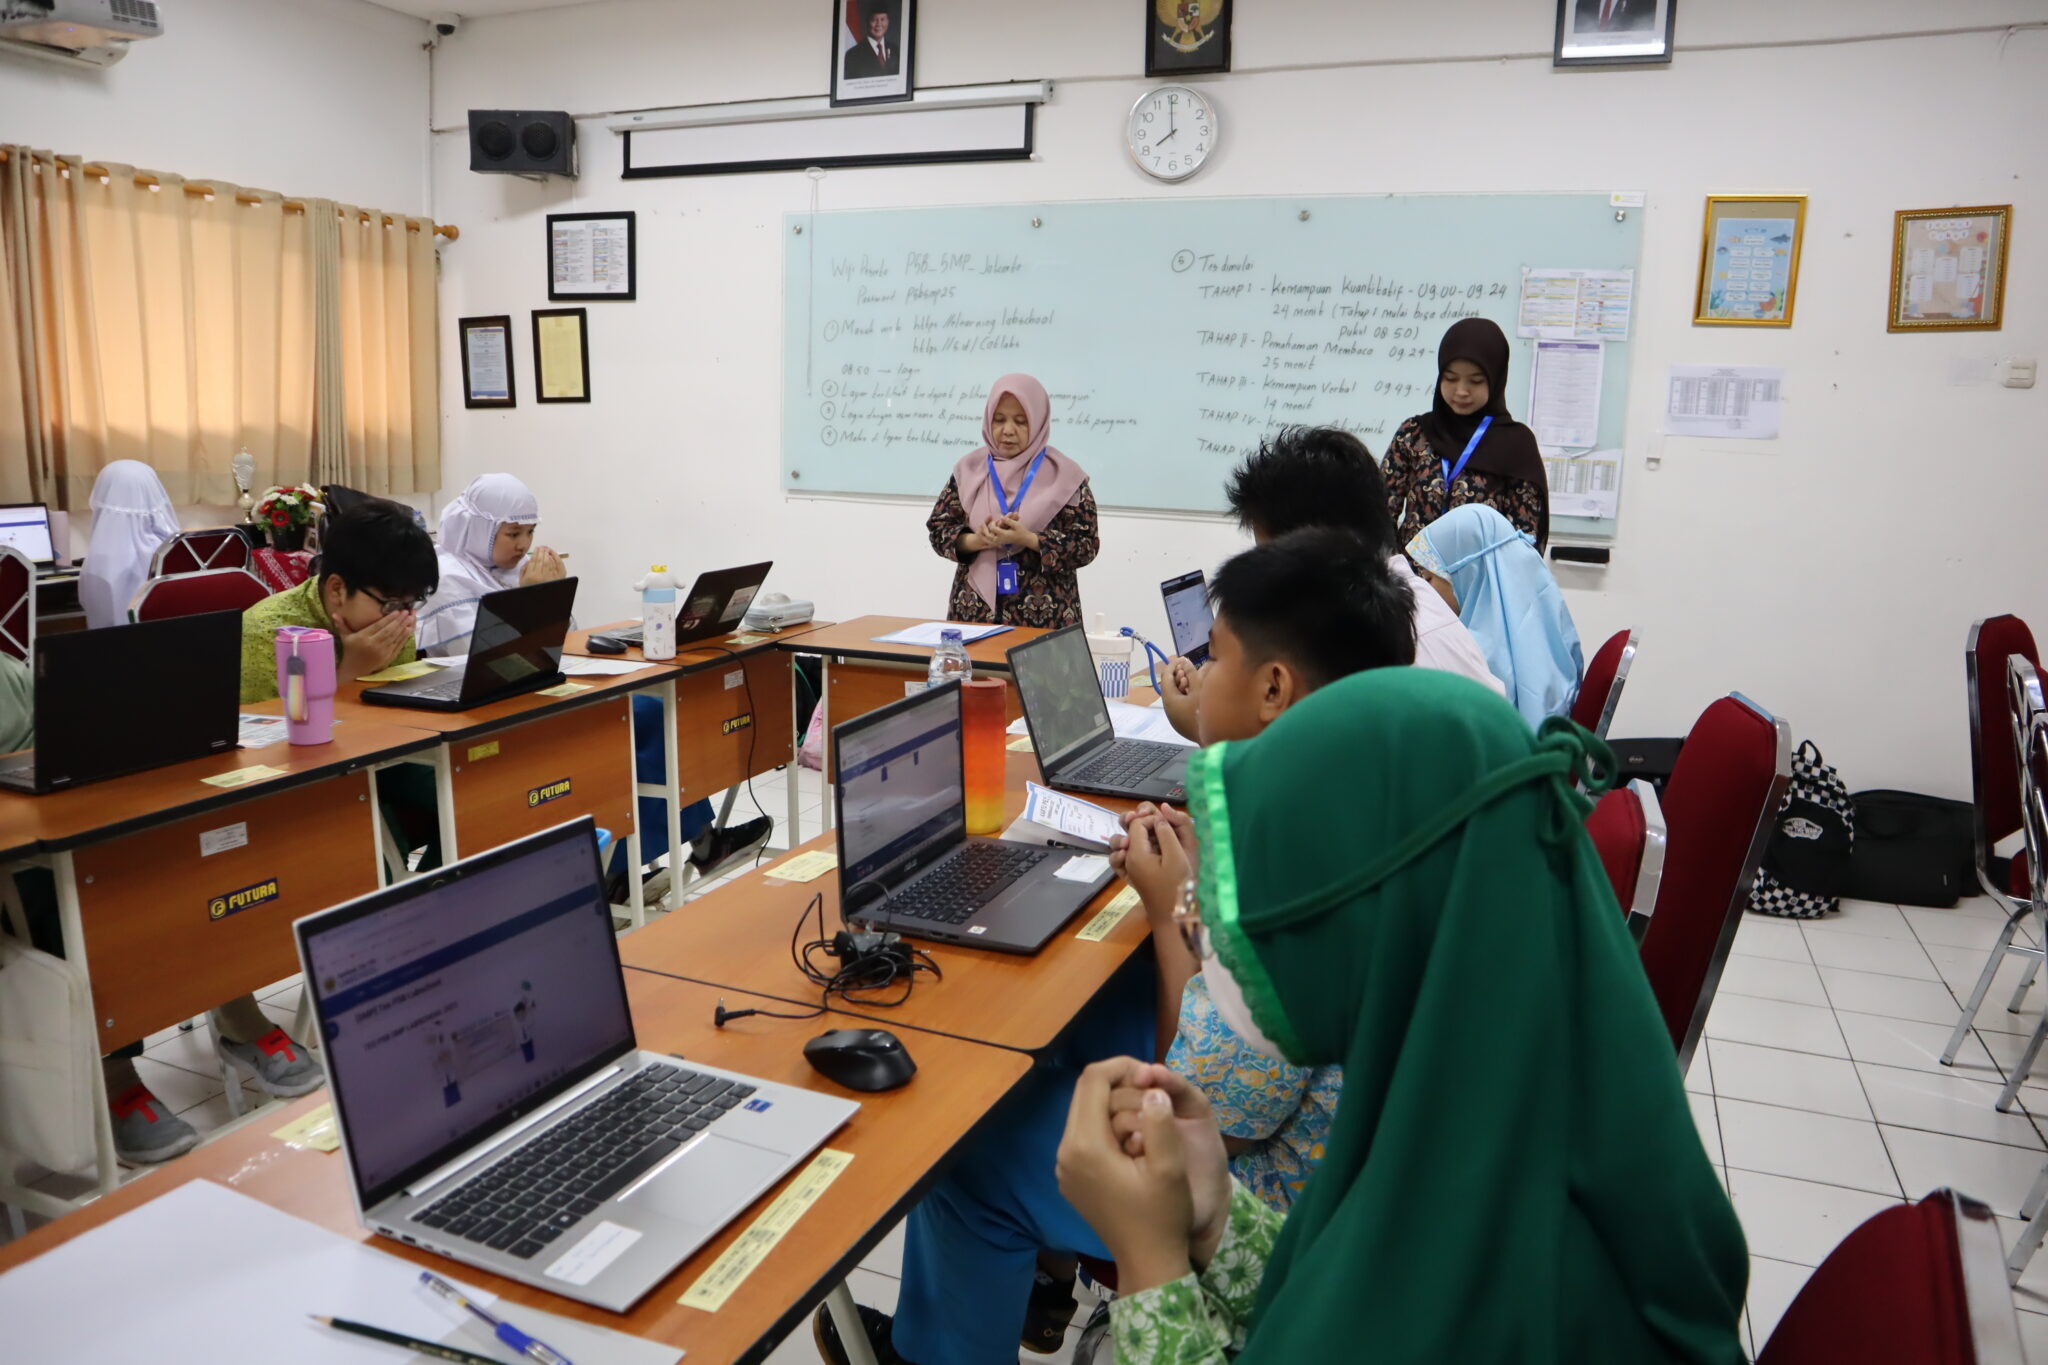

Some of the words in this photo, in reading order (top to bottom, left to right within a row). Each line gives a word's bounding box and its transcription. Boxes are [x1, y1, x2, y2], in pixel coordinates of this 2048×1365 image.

[1153, 100, 1161, 110] 11
[1187, 98, 1191, 109] 1
[1142, 112, 1154, 123] 10
[1195, 109, 1205, 120] 2
[1137, 129, 1146, 140] 9
[1200, 125, 1209, 136] 3
[1142, 145, 1151, 156] 8
[1195, 143, 1204, 153] 4
[1153, 156, 1161, 167] 7
[1184, 154, 1193, 165] 5
[1168, 160, 1178, 171] 6
[1198, 282, 1244, 299] TAHAP
[1271, 273, 1332, 302] Kemampuan
[1273, 303, 1289, 317] 24
[1293, 299, 1325, 318] menit
[1381, 302, 1408, 319] mulai
[1197, 330, 1238, 347] TAHAP
[1323, 341, 1374, 358] Membaca
[1283, 354, 1315, 370] menit
[1195, 371, 1236, 386] TAHAP
[1262, 373, 1318, 394] Kemampuan
[1281, 396, 1315, 410] menit
[1198, 407, 1239, 423] TAHAP
[1197, 437, 1237, 457] TAHAP
[540, 780, 571, 800] FUTURA
[228, 881, 277, 909] FUTURA
